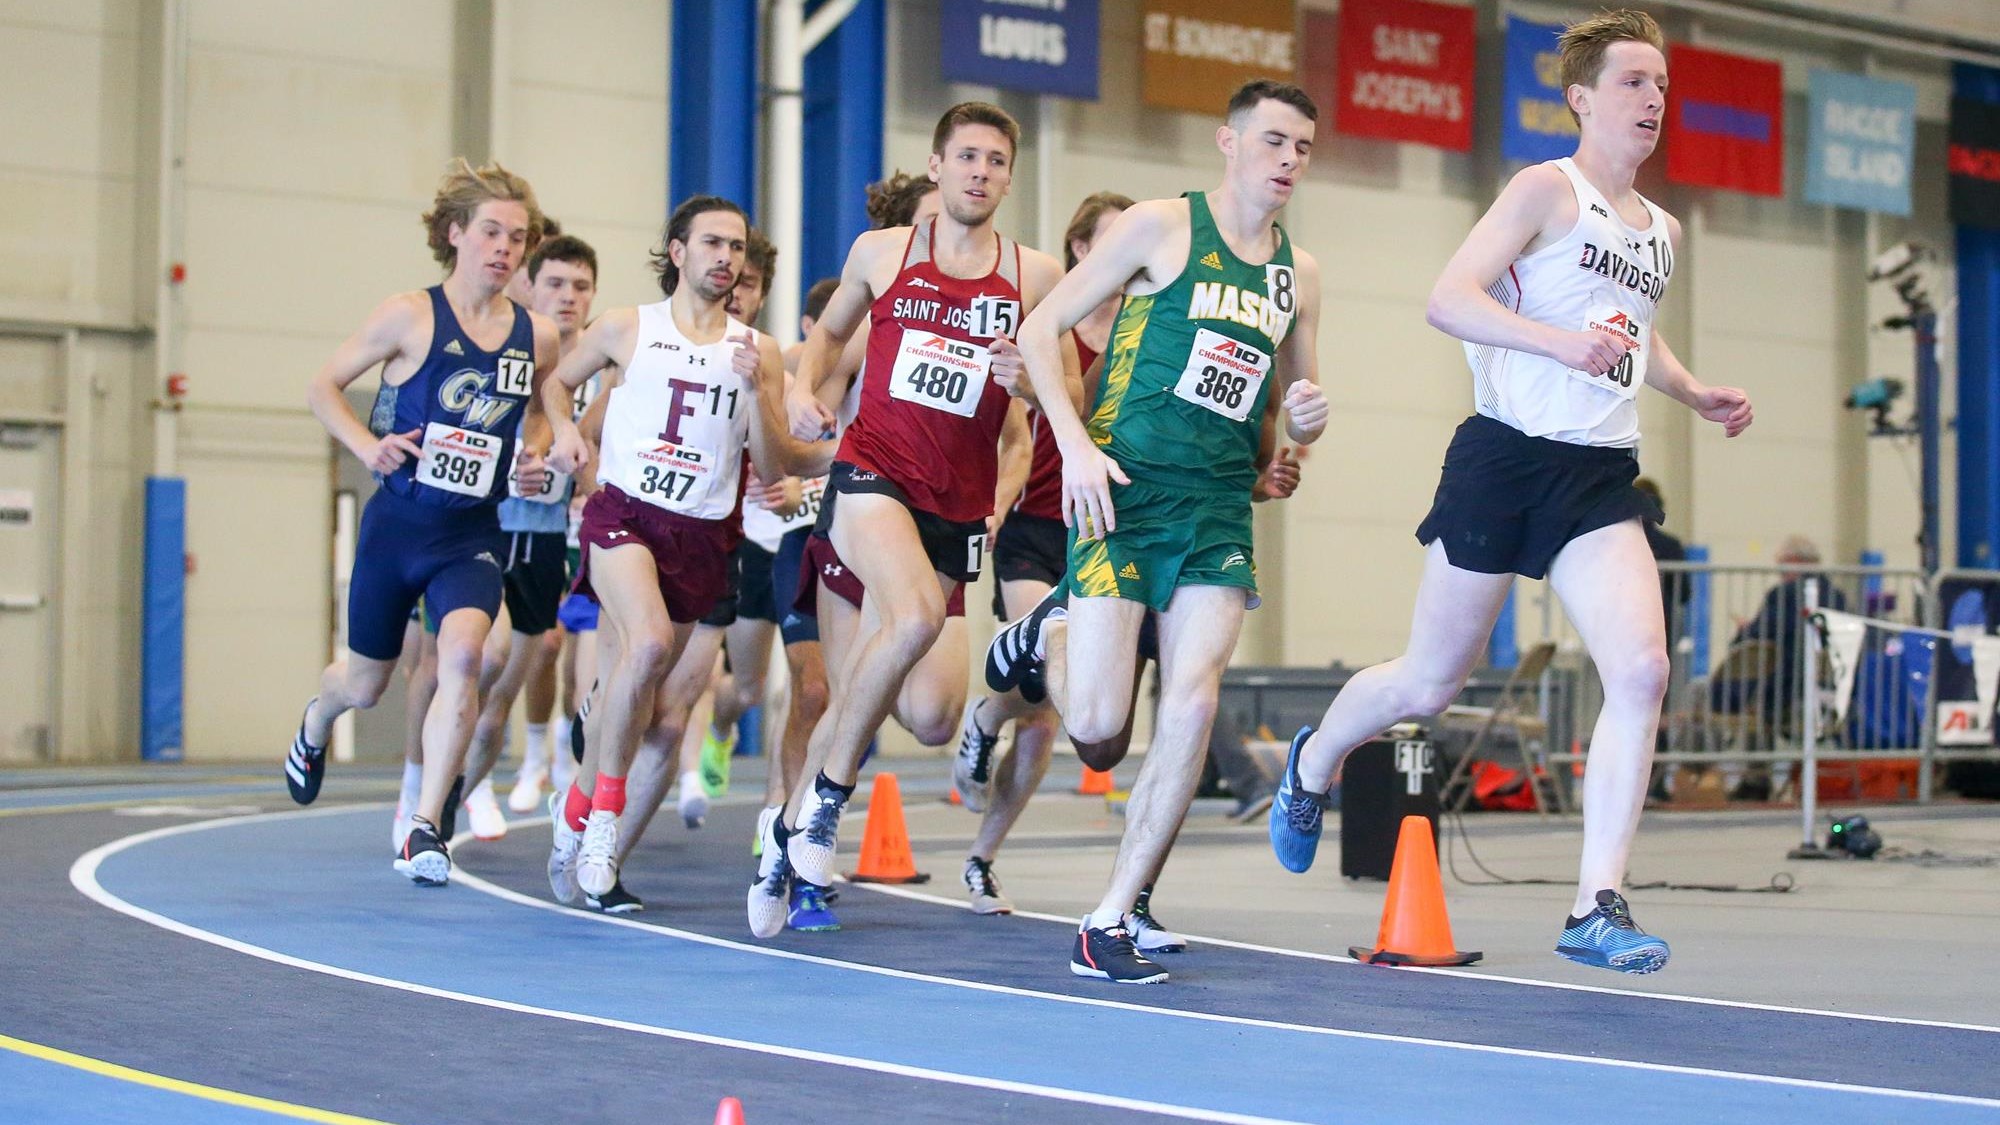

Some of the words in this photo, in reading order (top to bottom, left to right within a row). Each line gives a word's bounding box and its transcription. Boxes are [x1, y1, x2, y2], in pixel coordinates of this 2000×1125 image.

[1647, 236, 1672, 278] 10
[1273, 268, 1294, 314] 8
[892, 297, 941, 323] SAINT
[941, 306, 971, 331] JOS
[975, 300, 1012, 336] 15
[1187, 282, 1291, 350] MASON
[905, 346, 982, 372] CHAMPIONSHIPS
[922, 335, 975, 359] A10
[1212, 339, 1260, 365] A10
[502, 361, 528, 392] 14
[1198, 348, 1262, 378] CHAMPIONSHIPS
[907, 362, 968, 404] 480
[1195, 365, 1248, 409] 368
[658, 377, 707, 446] F
[709, 384, 738, 420] 11
[444, 429, 488, 448] A10
[652, 442, 702, 463] A10
[431, 452, 482, 487] 393
[637, 450, 709, 474] CHAMPIONSHIPS
[640, 465, 697, 502] 347
[1118, 571, 1141, 580] adidas
